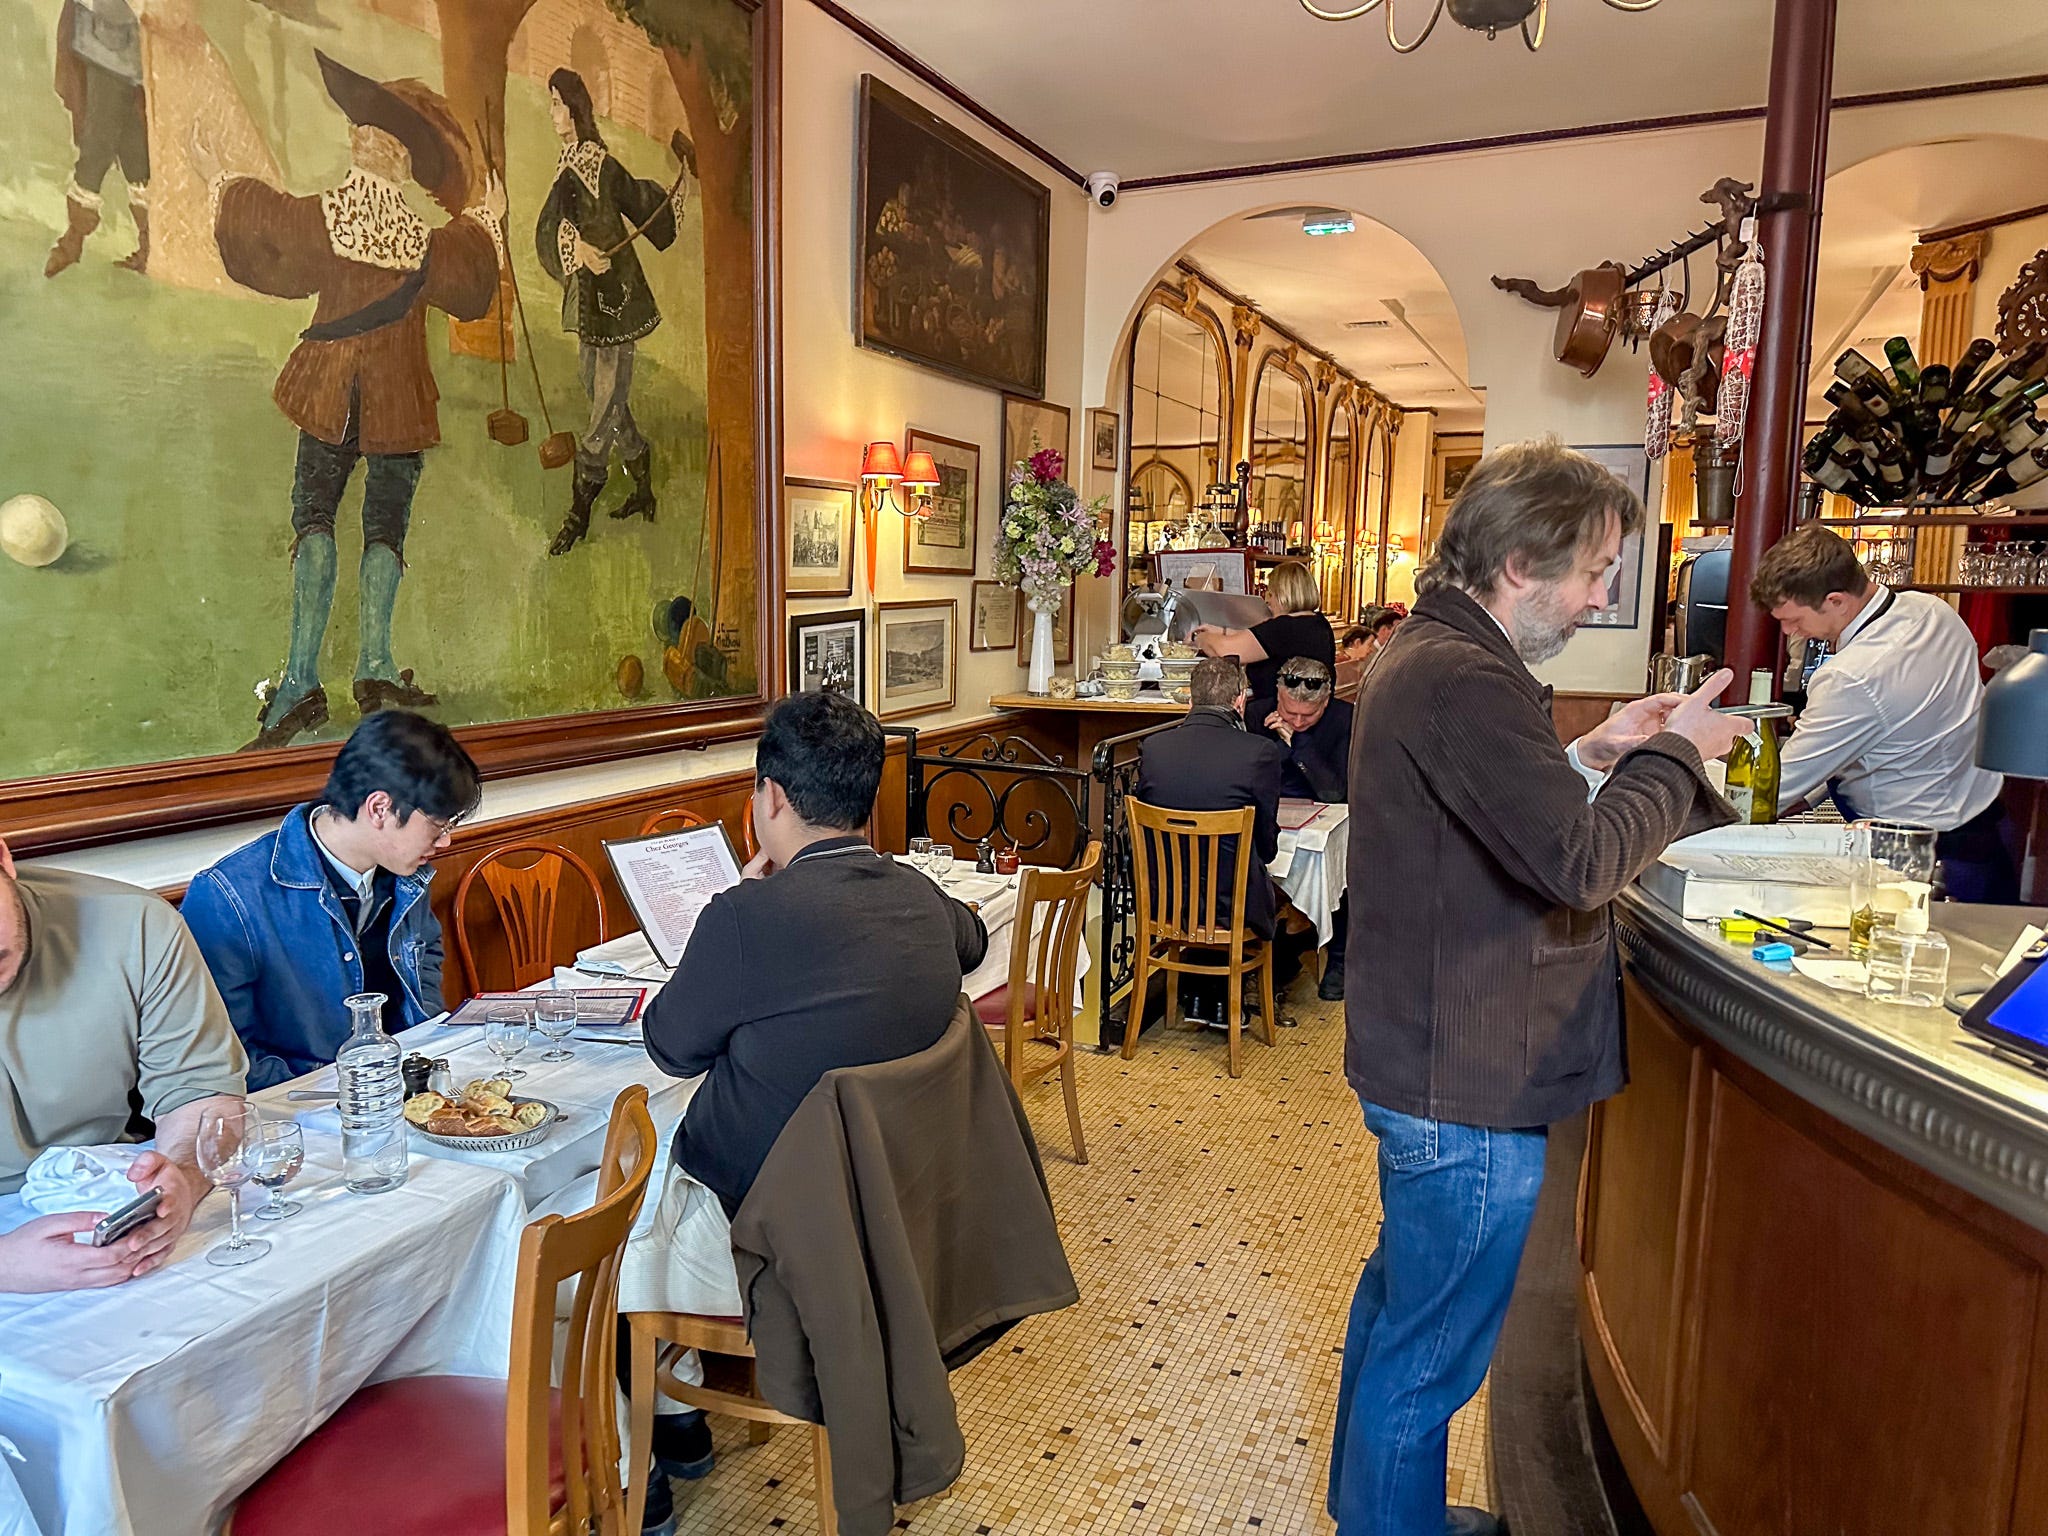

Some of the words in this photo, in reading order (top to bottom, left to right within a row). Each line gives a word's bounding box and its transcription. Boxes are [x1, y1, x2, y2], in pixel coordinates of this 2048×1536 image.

[1593, 612, 1618, 624] ES
[645, 845, 662, 853] Chez
[662, 841, 689, 850] Georges
